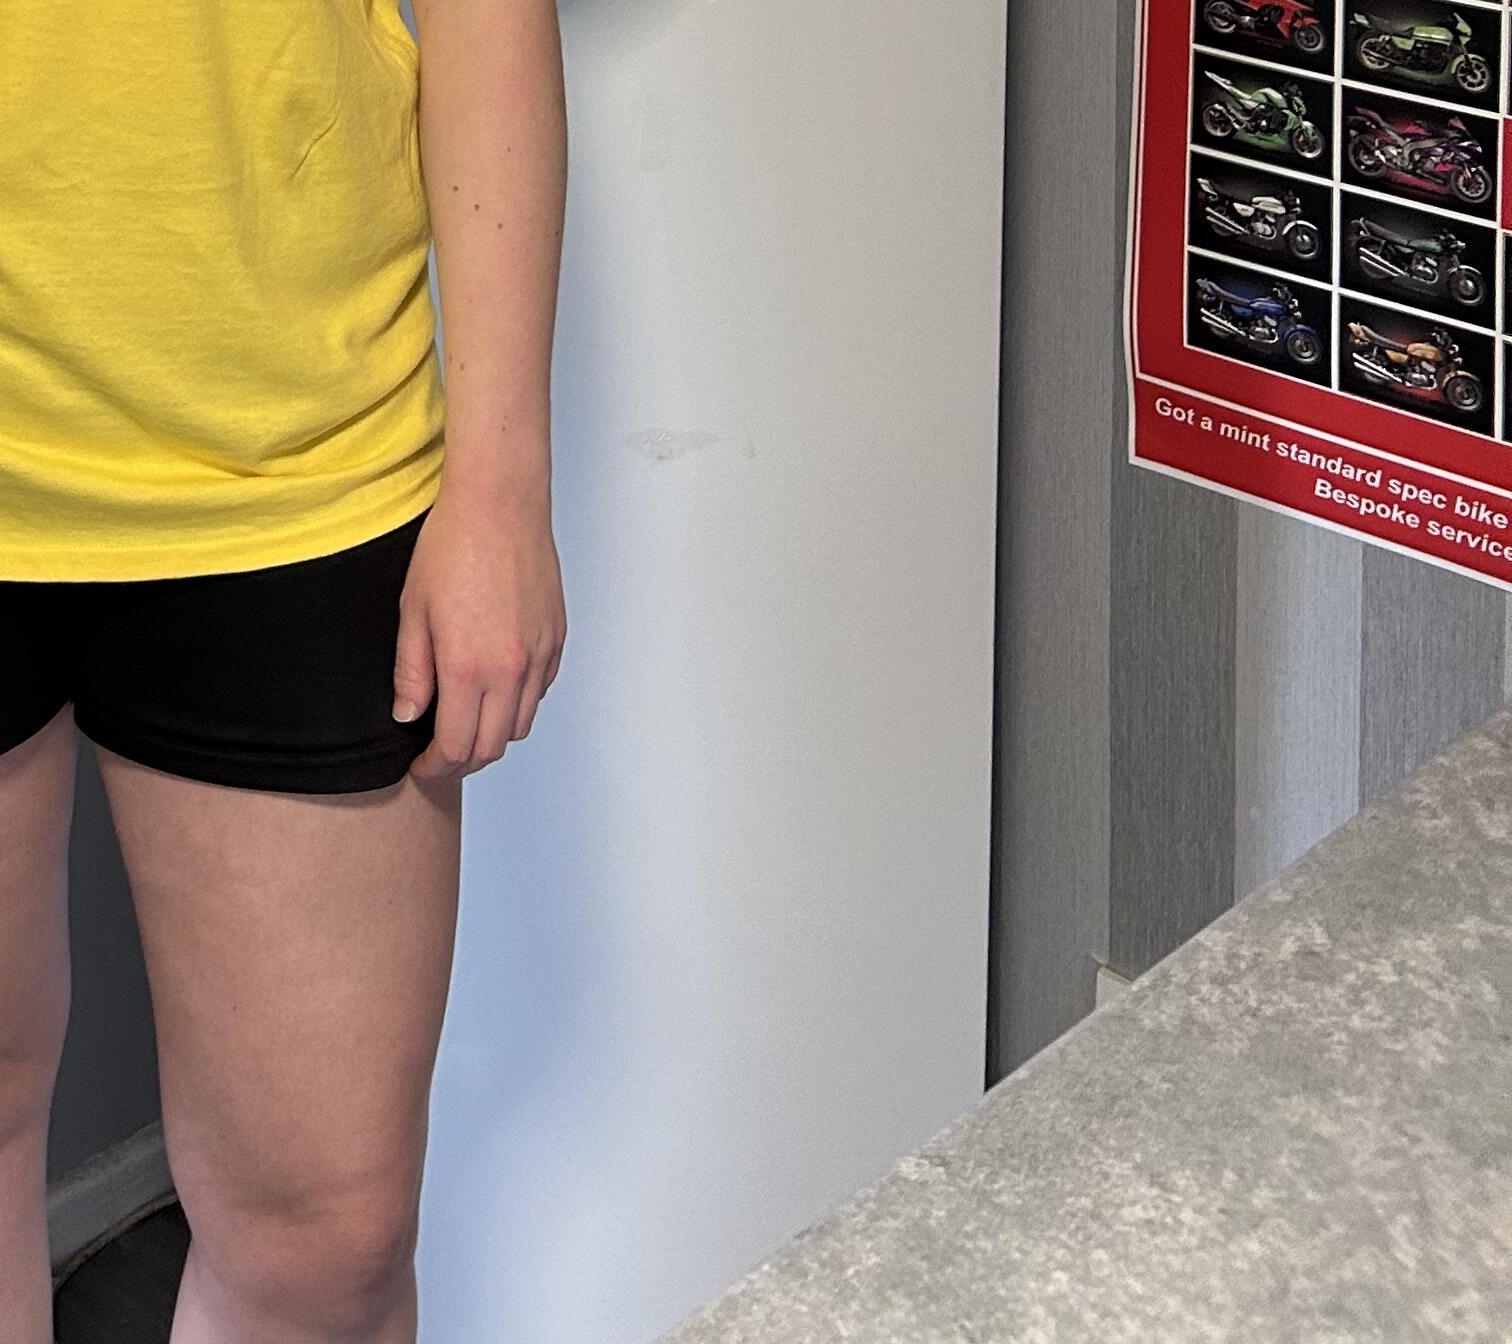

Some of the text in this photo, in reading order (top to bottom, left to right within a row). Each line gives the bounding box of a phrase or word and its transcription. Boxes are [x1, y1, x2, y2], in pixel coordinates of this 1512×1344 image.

[1155, 397, 1509, 529] Got a mint standard spec bike
[1313, 477, 1421, 529] Bespoke
